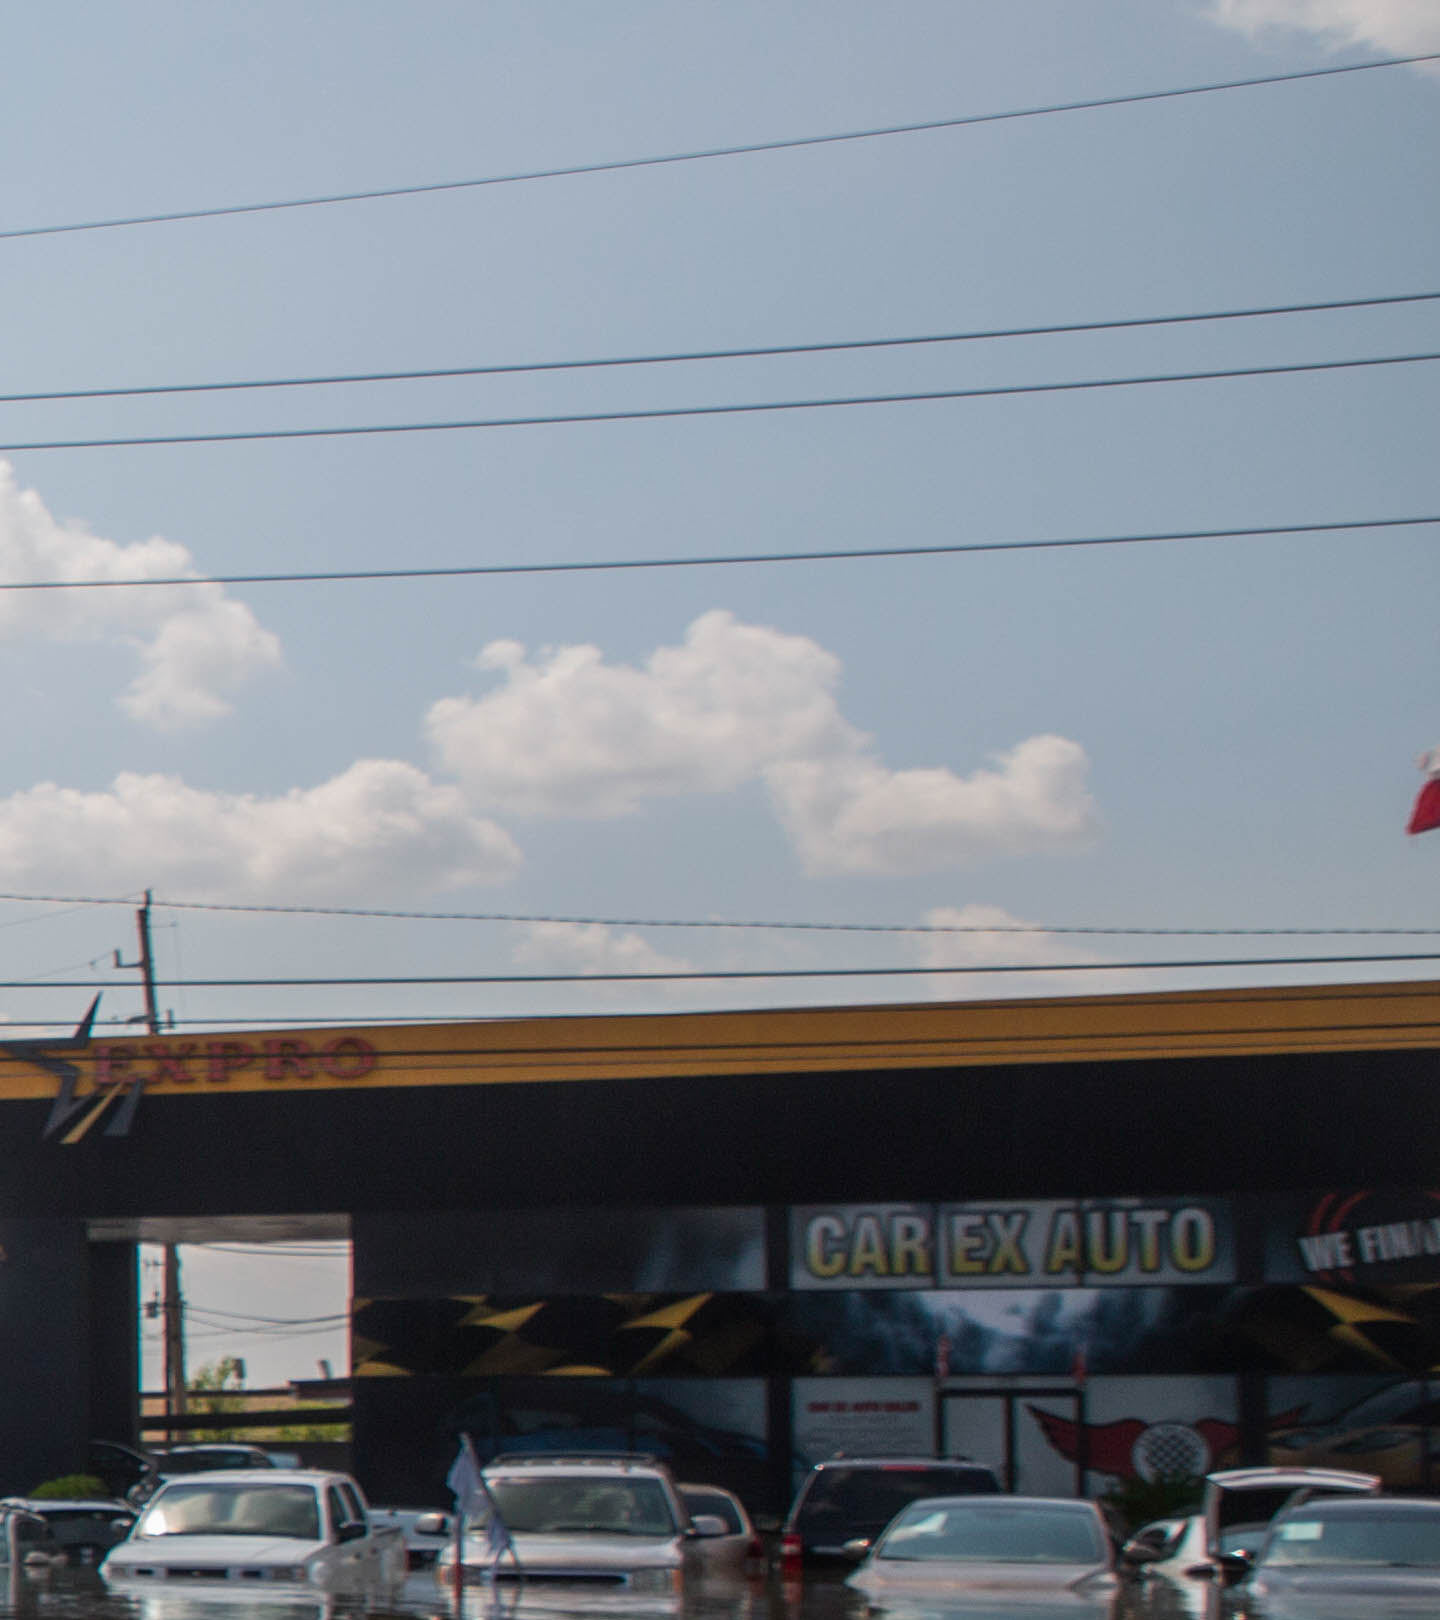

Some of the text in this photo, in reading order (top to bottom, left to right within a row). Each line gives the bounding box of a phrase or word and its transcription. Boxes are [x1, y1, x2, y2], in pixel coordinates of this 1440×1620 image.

[806, 1208, 1215, 1278] CAR EX AUTO
[1297, 1230, 1355, 1272] WE
